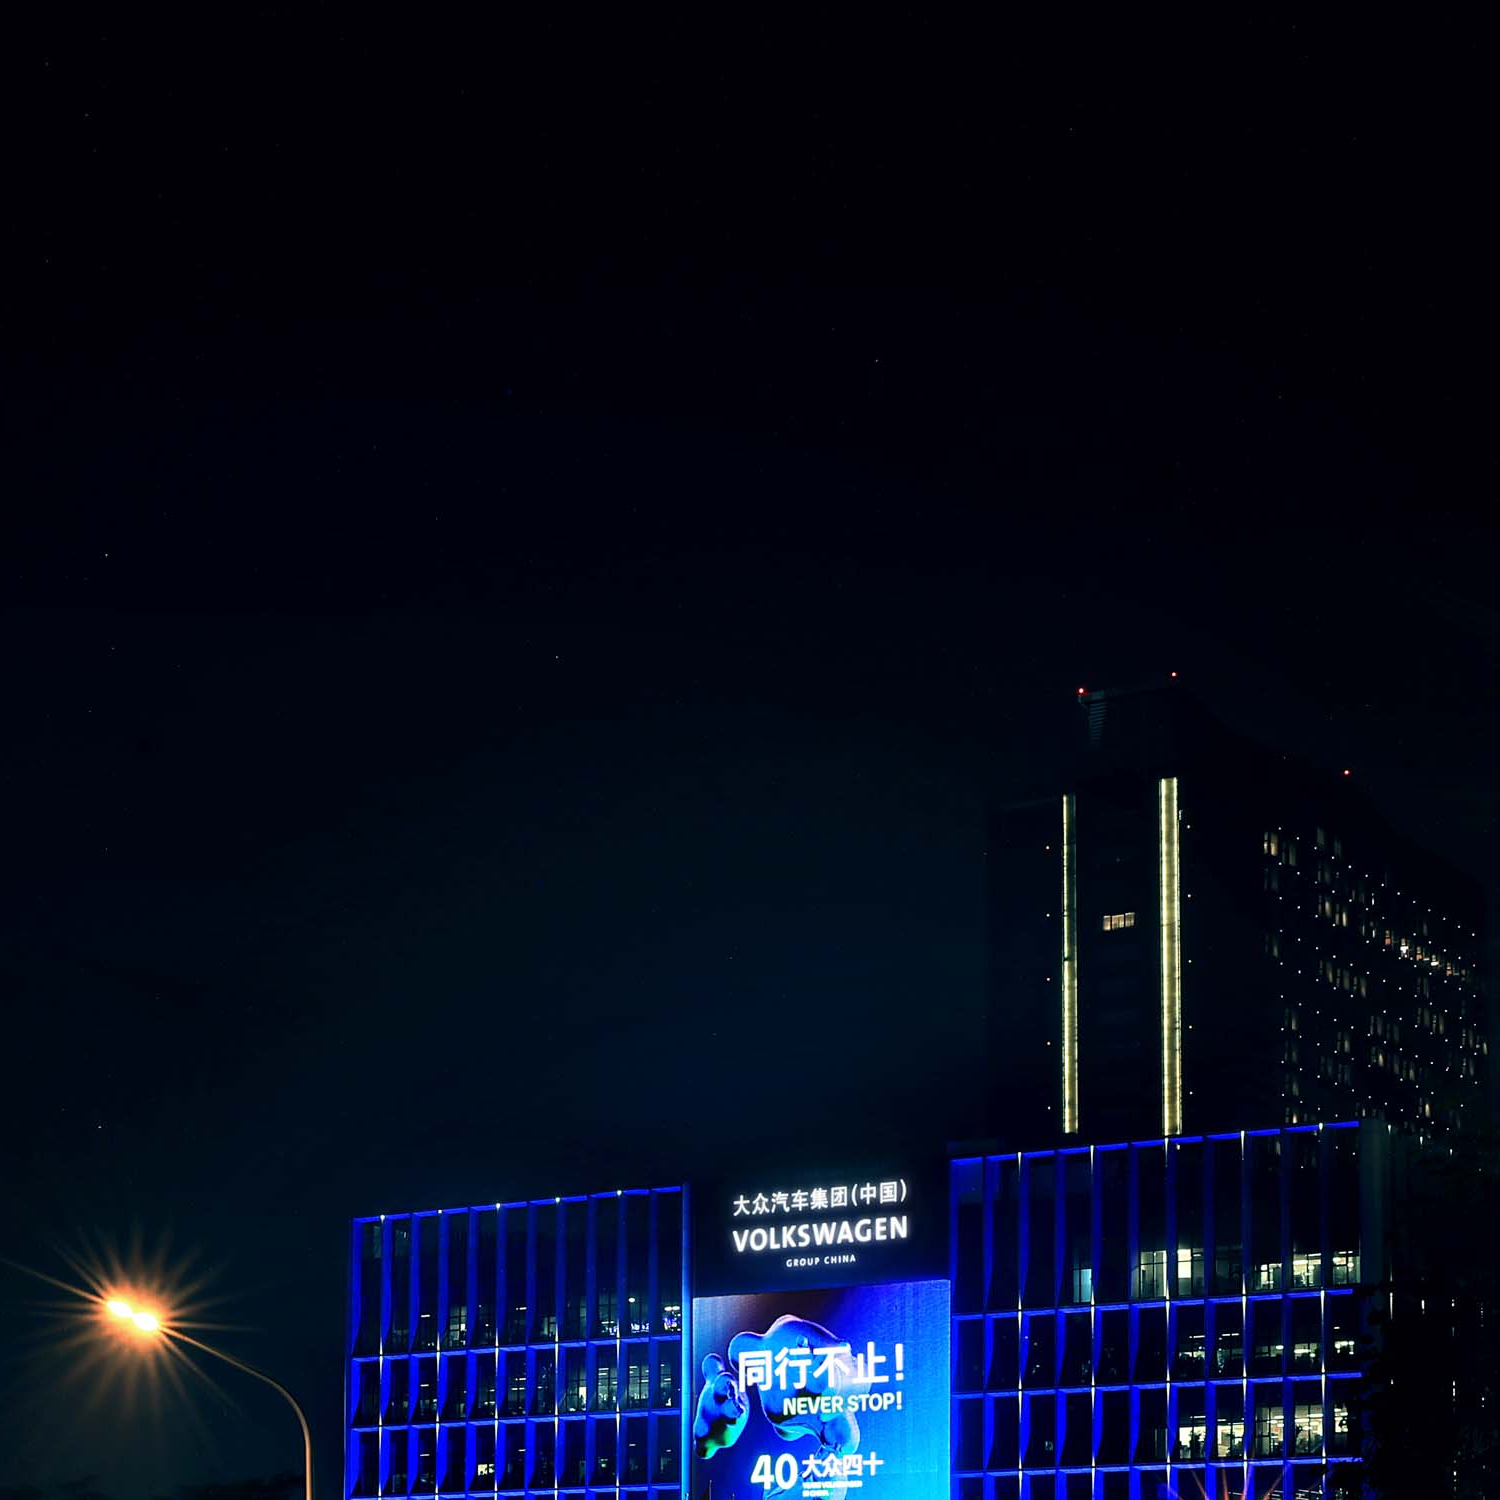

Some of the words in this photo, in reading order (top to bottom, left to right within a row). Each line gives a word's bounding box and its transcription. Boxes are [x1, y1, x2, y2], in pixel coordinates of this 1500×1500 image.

[733, 1179, 907, 1216] 大众汽车集团(中国)
[732, 1215, 908, 1253] VOLKSWAGEN
[786, 1256, 820, 1268] GROUP
[824, 1254, 856, 1264] CHINA
[783, 1397, 845, 1416] NEVER
[847, 1391, 903, 1412] STOP!
[750, 1453, 798, 1490] 40
[802, 1452, 885, 1478] 大众四十
